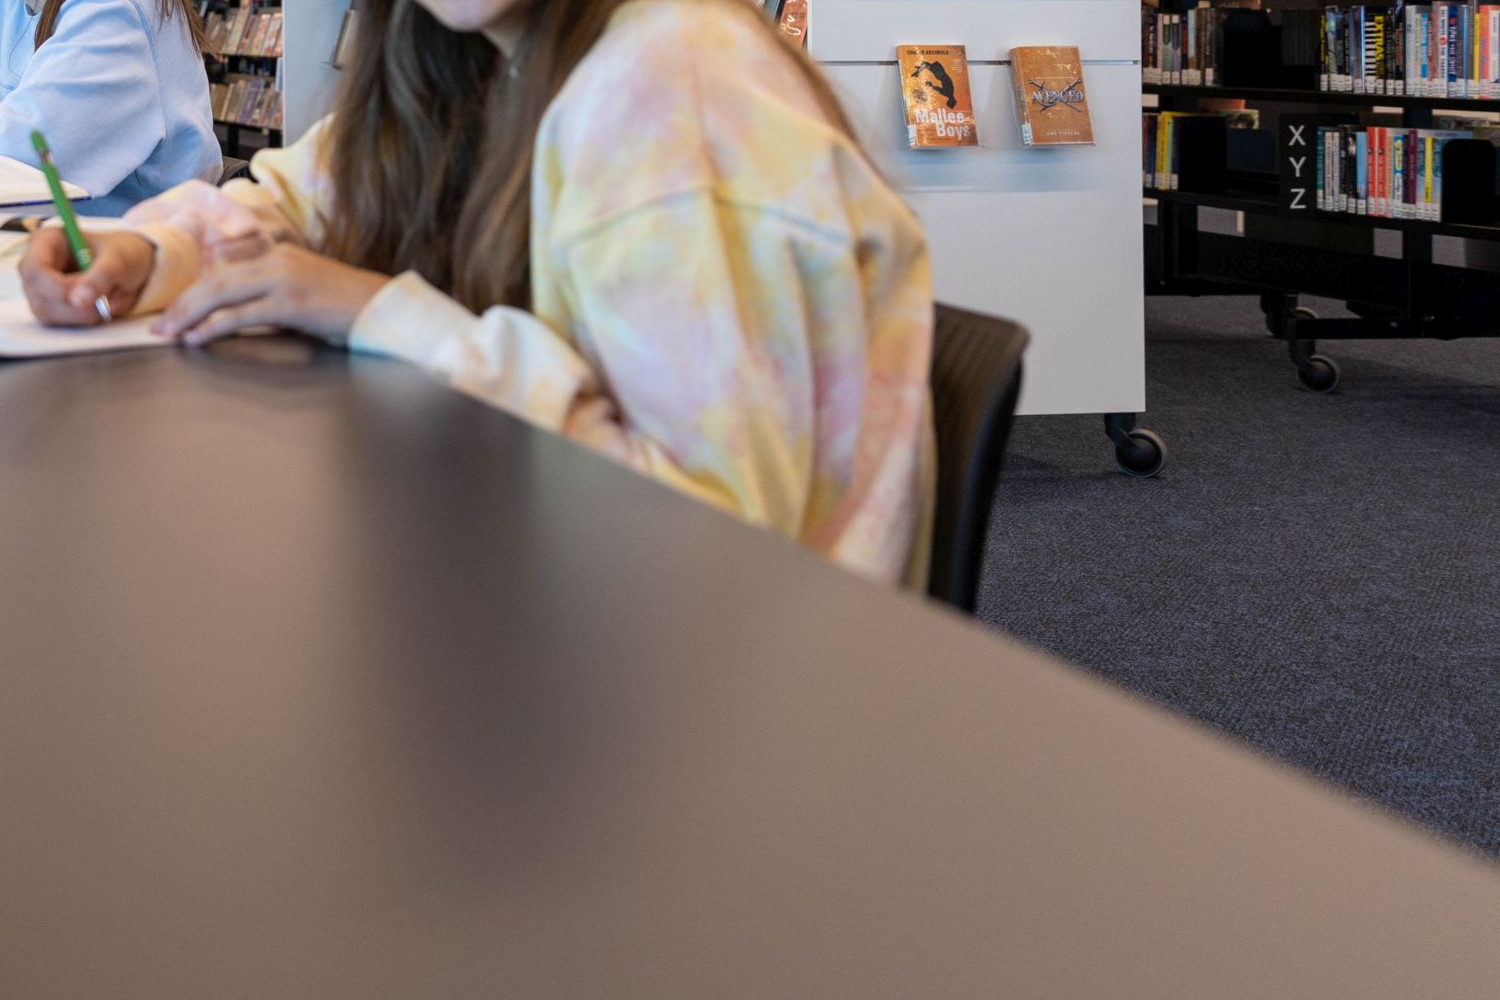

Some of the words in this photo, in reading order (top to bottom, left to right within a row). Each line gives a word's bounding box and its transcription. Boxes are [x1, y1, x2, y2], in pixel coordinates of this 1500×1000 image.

[1374, 15, 1384, 61] EXTRAS
[915, 109, 965, 124] Mallee
[936, 121, 972, 140] Boys
[1288, 124, 1307, 146] X
[1288, 156, 1307, 178] Y
[1289, 188, 1307, 210] Z
